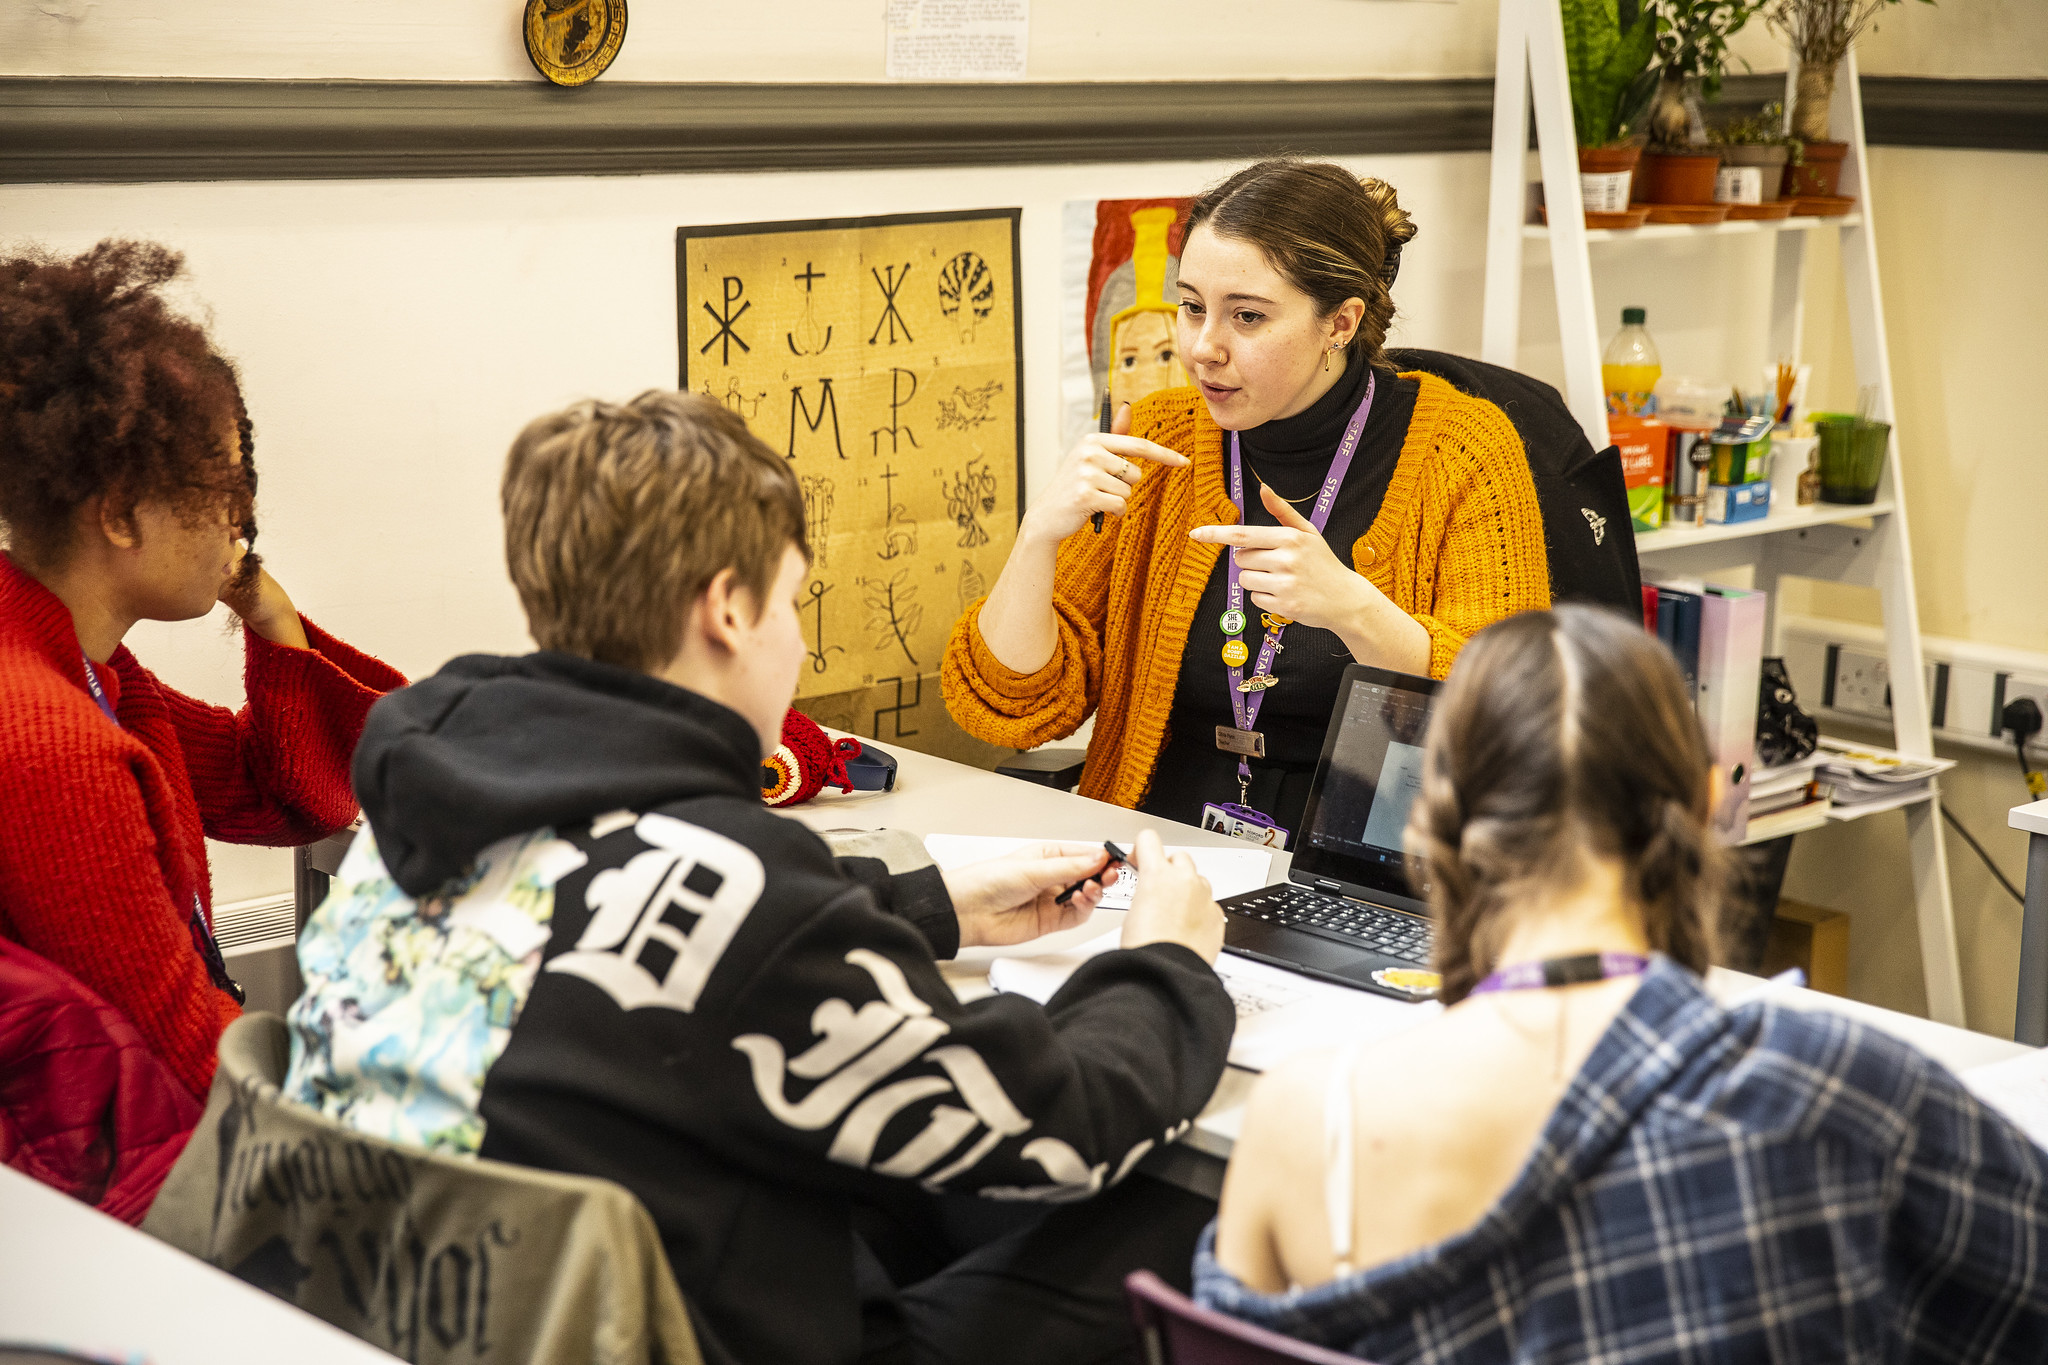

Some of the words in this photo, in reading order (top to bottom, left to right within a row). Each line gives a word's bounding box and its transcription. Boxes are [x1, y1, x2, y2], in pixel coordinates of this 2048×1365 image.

[1340, 420, 1361, 457] STAFF
[1233, 464, 1242, 500] STAFF
[1317, 476, 1338, 514] STAFF
[1231, 582, 1241, 611] TAFF
[1227, 613, 1238, 621] SHE
[1227, 622, 1239, 630] HER
[1256, 648, 1271, 678] STAF
[1235, 700, 1245, 729] TAFF
